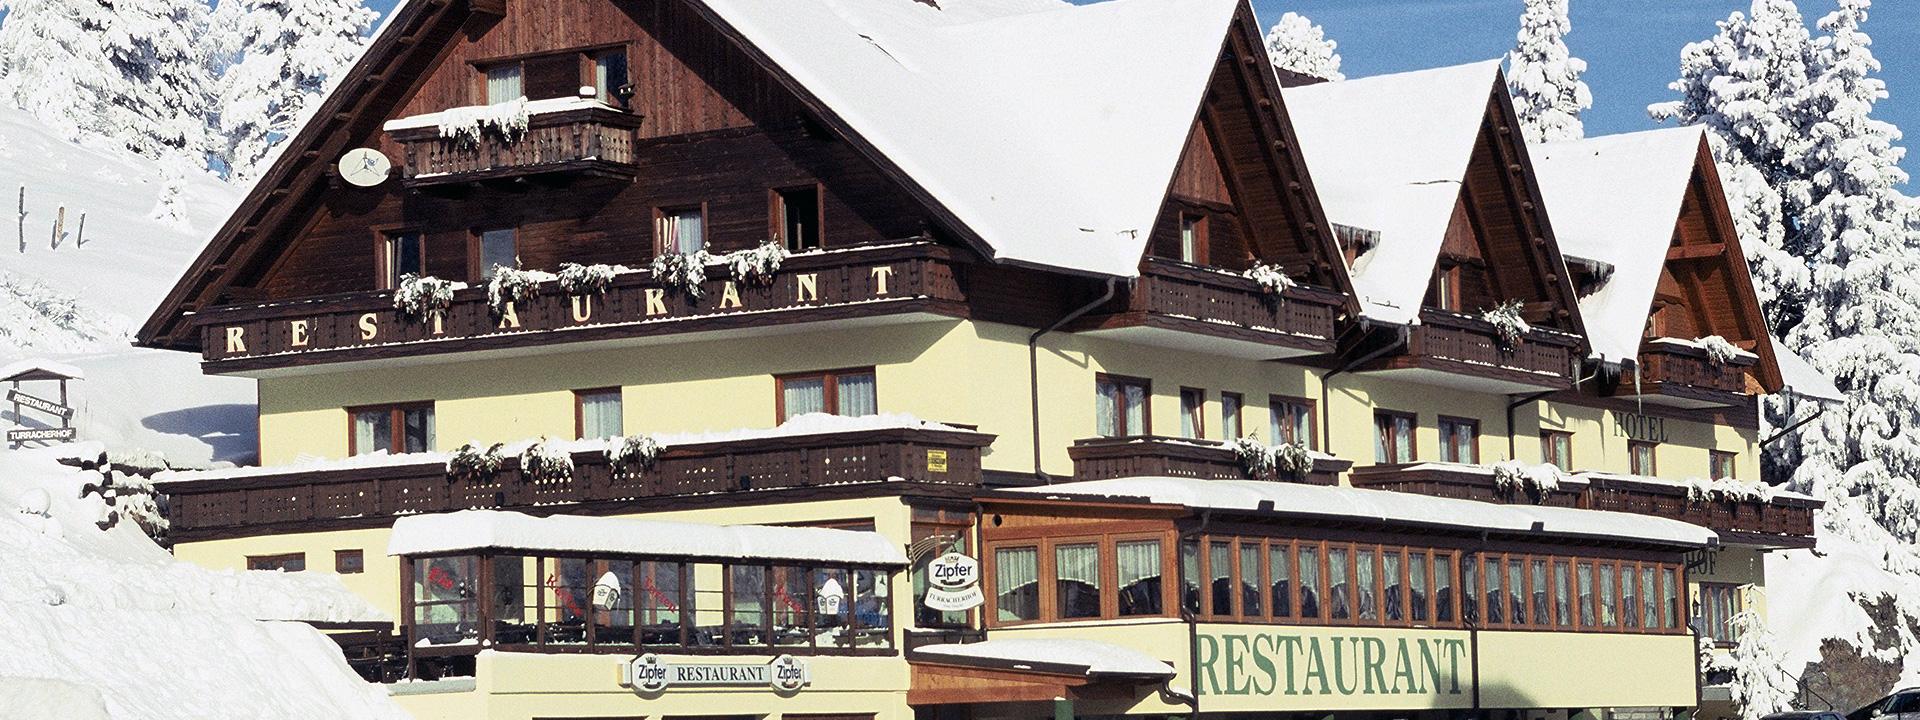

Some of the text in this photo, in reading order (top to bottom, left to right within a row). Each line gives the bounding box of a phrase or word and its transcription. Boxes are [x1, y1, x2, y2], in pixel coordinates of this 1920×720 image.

[226, 266, 893, 353] RESTAURANT
[13, 393, 68, 416] RESTAURANT
[9, 429, 73, 440] TURRACHERHOF
[1613, 411, 1669, 443] HOTEL
[935, 563, 972, 580] Zipfer
[638, 664, 666, 683] Zipfer
[677, 666, 765, 681] RESTAURANT
[777, 664, 802, 682] Zipfer
[1196, 633, 1466, 696] RESTAURANT
